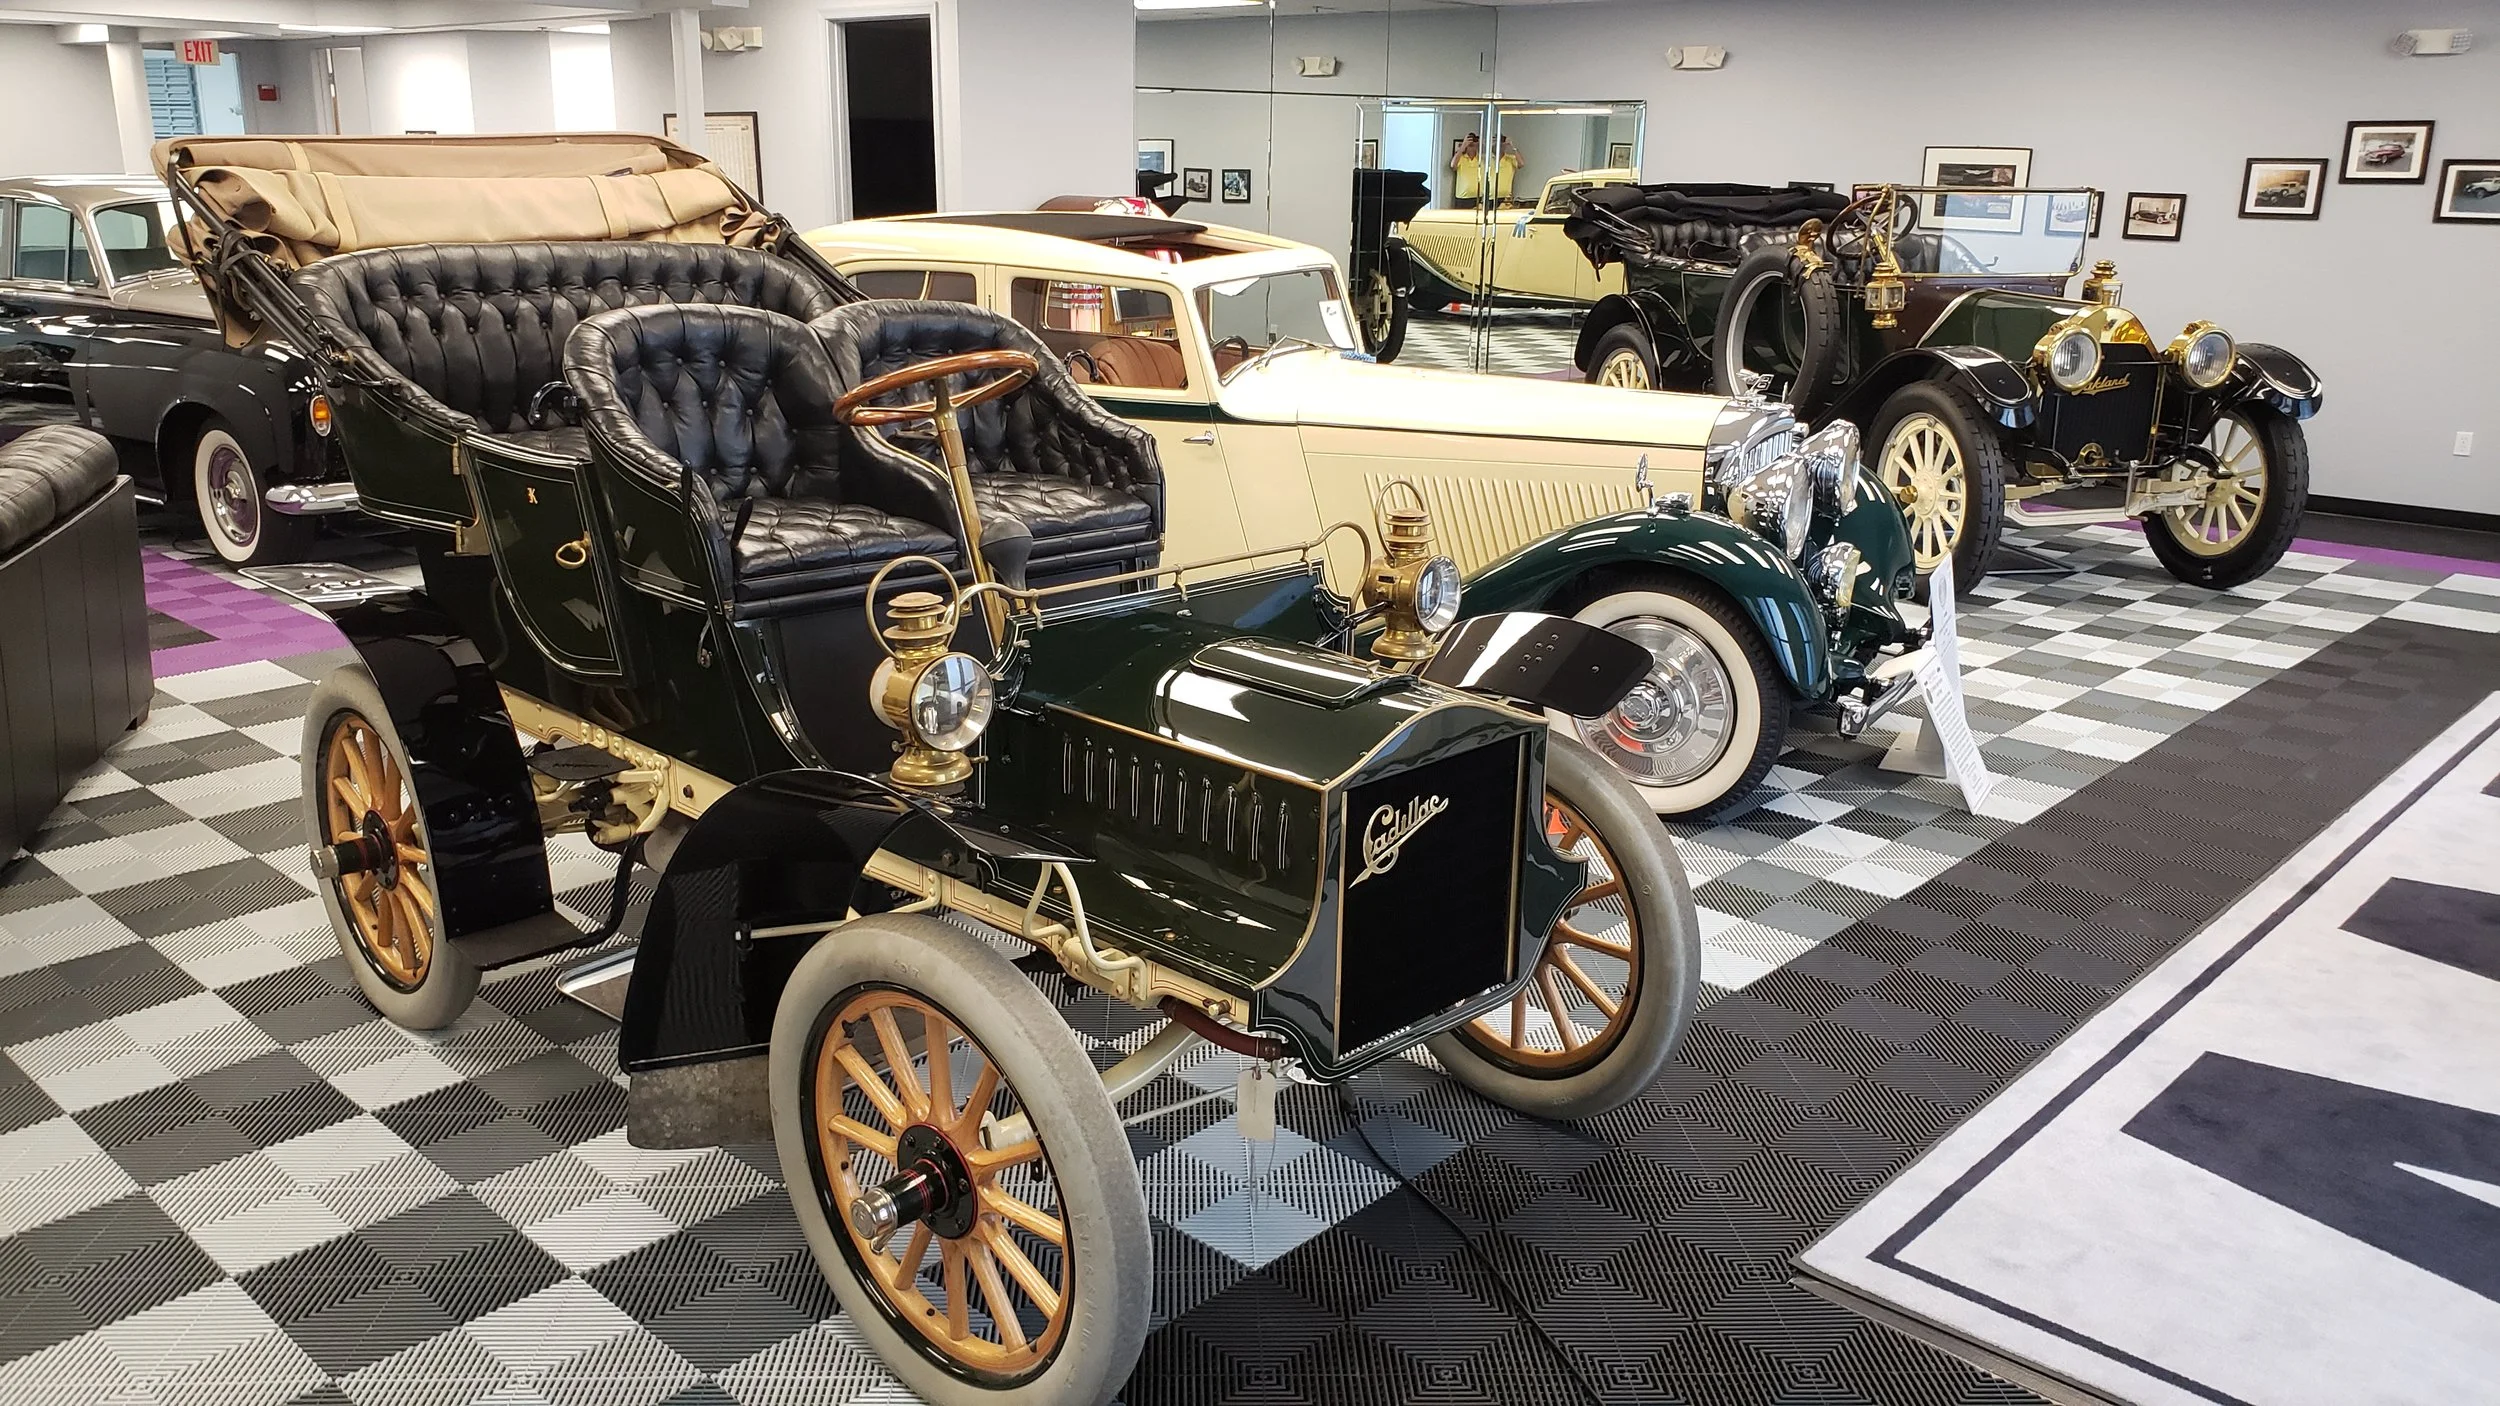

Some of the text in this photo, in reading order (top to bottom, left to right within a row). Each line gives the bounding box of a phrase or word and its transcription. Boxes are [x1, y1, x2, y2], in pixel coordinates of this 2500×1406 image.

[184, 40, 212, 62] EXIT
[2071, 373, 2131, 395] akland
[1349, 795, 1449, 888] Cadillac
